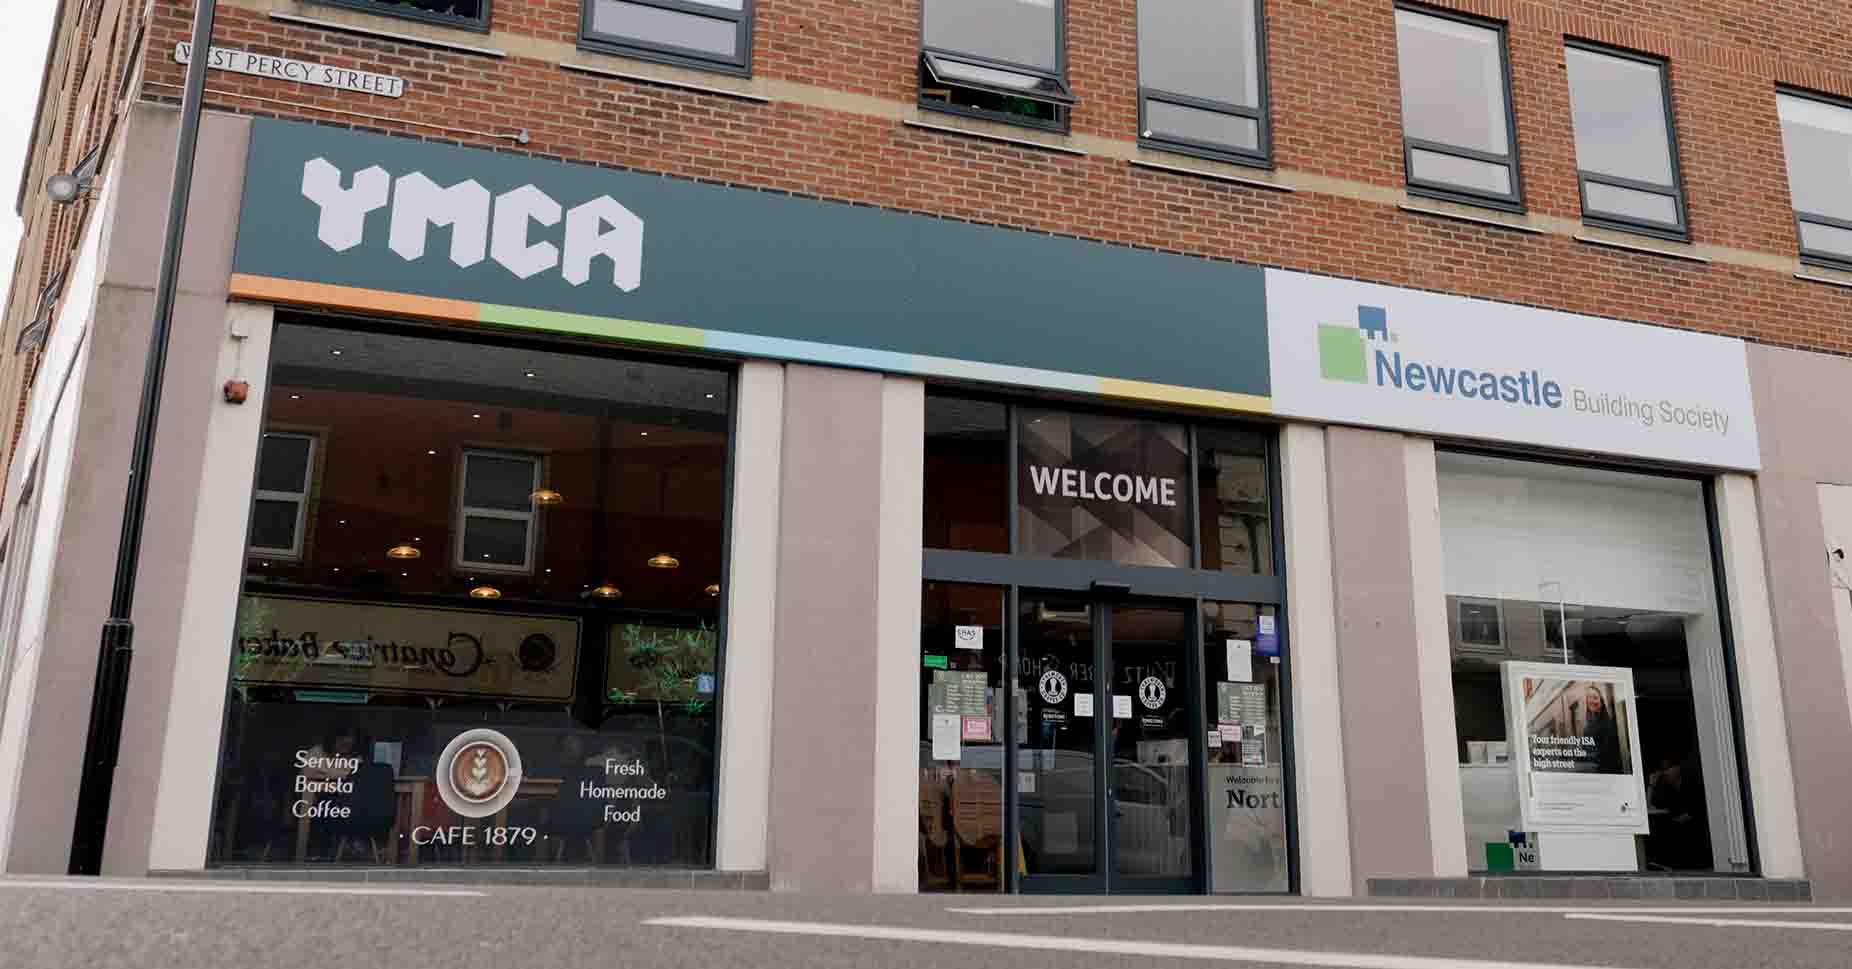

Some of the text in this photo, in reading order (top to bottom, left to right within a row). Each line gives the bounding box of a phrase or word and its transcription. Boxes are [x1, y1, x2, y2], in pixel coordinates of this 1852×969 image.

[246, 54, 316, 82] PERCY
[324, 67, 401, 95] STREET
[301, 157, 644, 293] YMCA
[1374, 349, 1730, 436] Newcastle Building Society
[1030, 465, 1177, 506] WELCOME
[1531, 734, 1595, 747] Your friendly ISA
[1532, 748, 1562, 757] experts
[1574, 748, 1587, 757] the
[294, 751, 359, 774] Serving
[605, 758, 644, 776] Fresh
[1533, 757, 1575, 769] high street
[295, 775, 353, 795] Barista
[579, 782, 667, 800] Homemade
[292, 800, 351, 819] Coffee
[604, 805, 641, 823] Food
[412, 825, 537, 846] CAFE 1879
[1519, 851, 1535, 863] Ne
